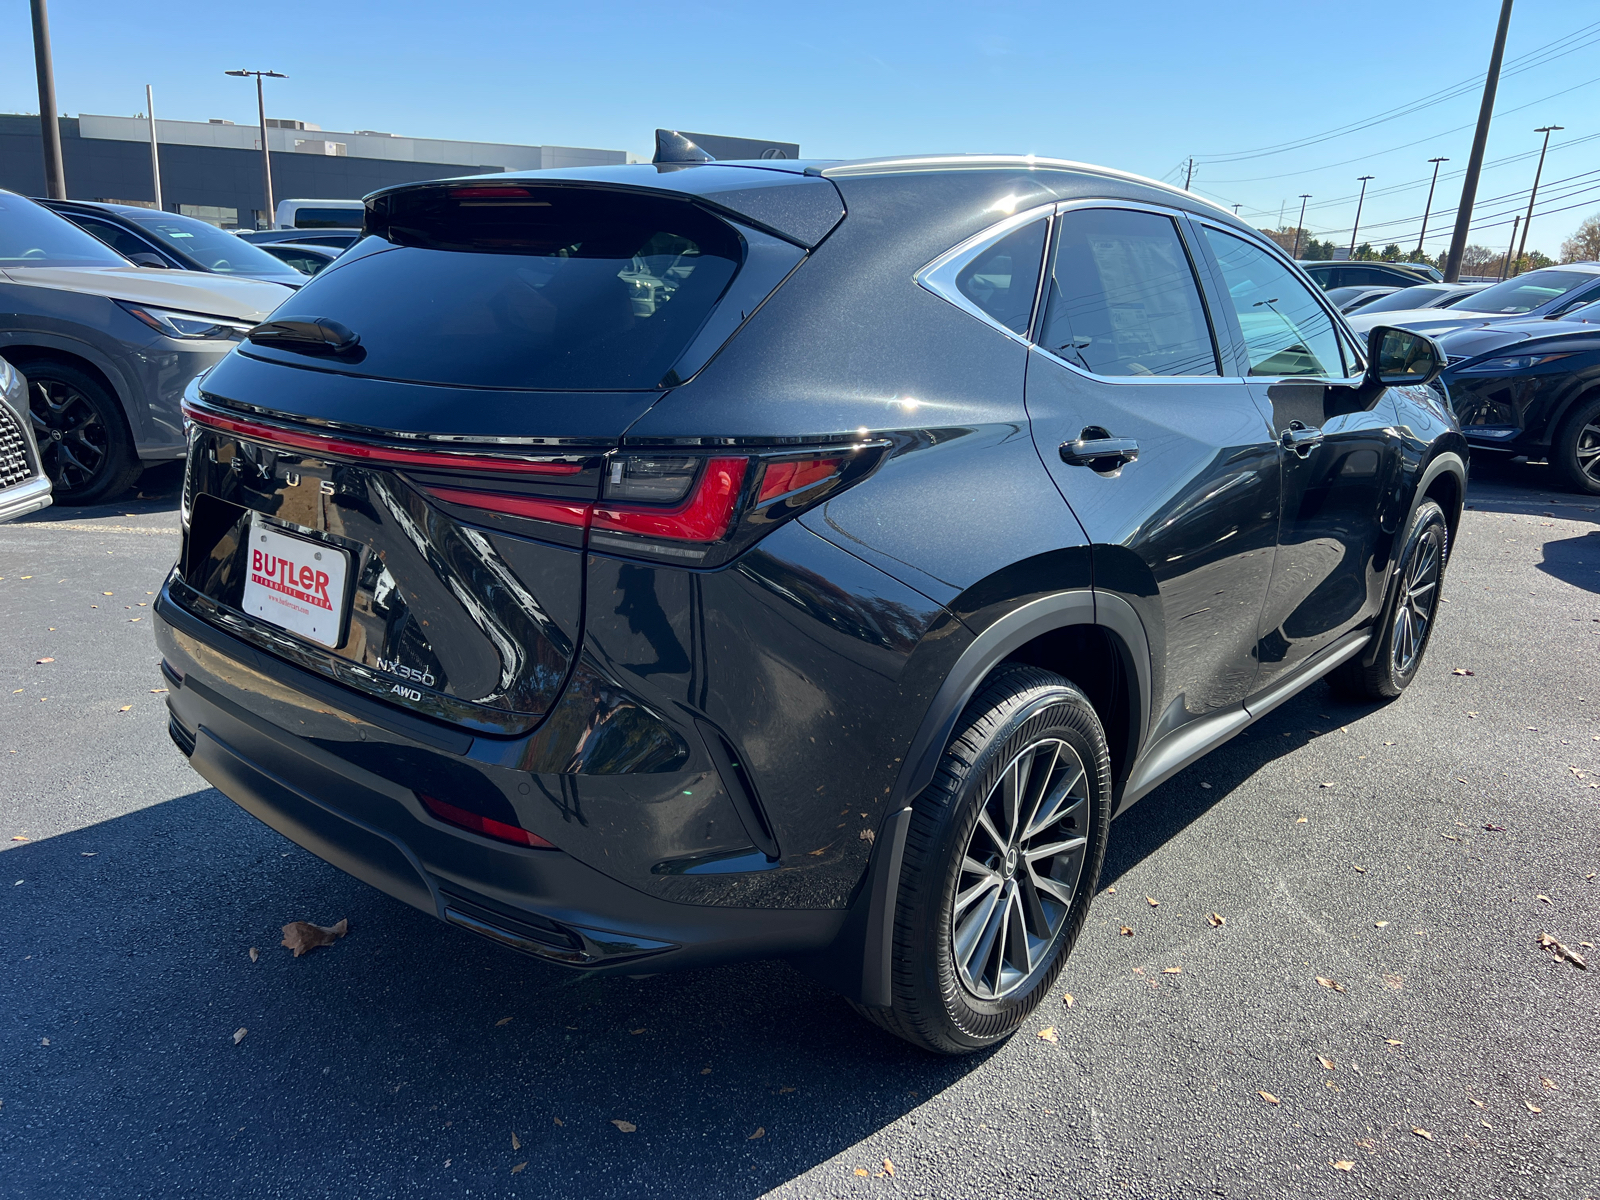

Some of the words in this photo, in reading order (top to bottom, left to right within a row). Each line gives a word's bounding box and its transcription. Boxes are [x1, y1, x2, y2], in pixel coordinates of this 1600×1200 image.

[208, 448, 336, 496] LEXUS
[251, 573, 297, 597] AUTOMOTIVE
[303, 593, 331, 609] GROUP
[376, 656, 435, 687] NX350
[390, 684, 422, 702] AWD
